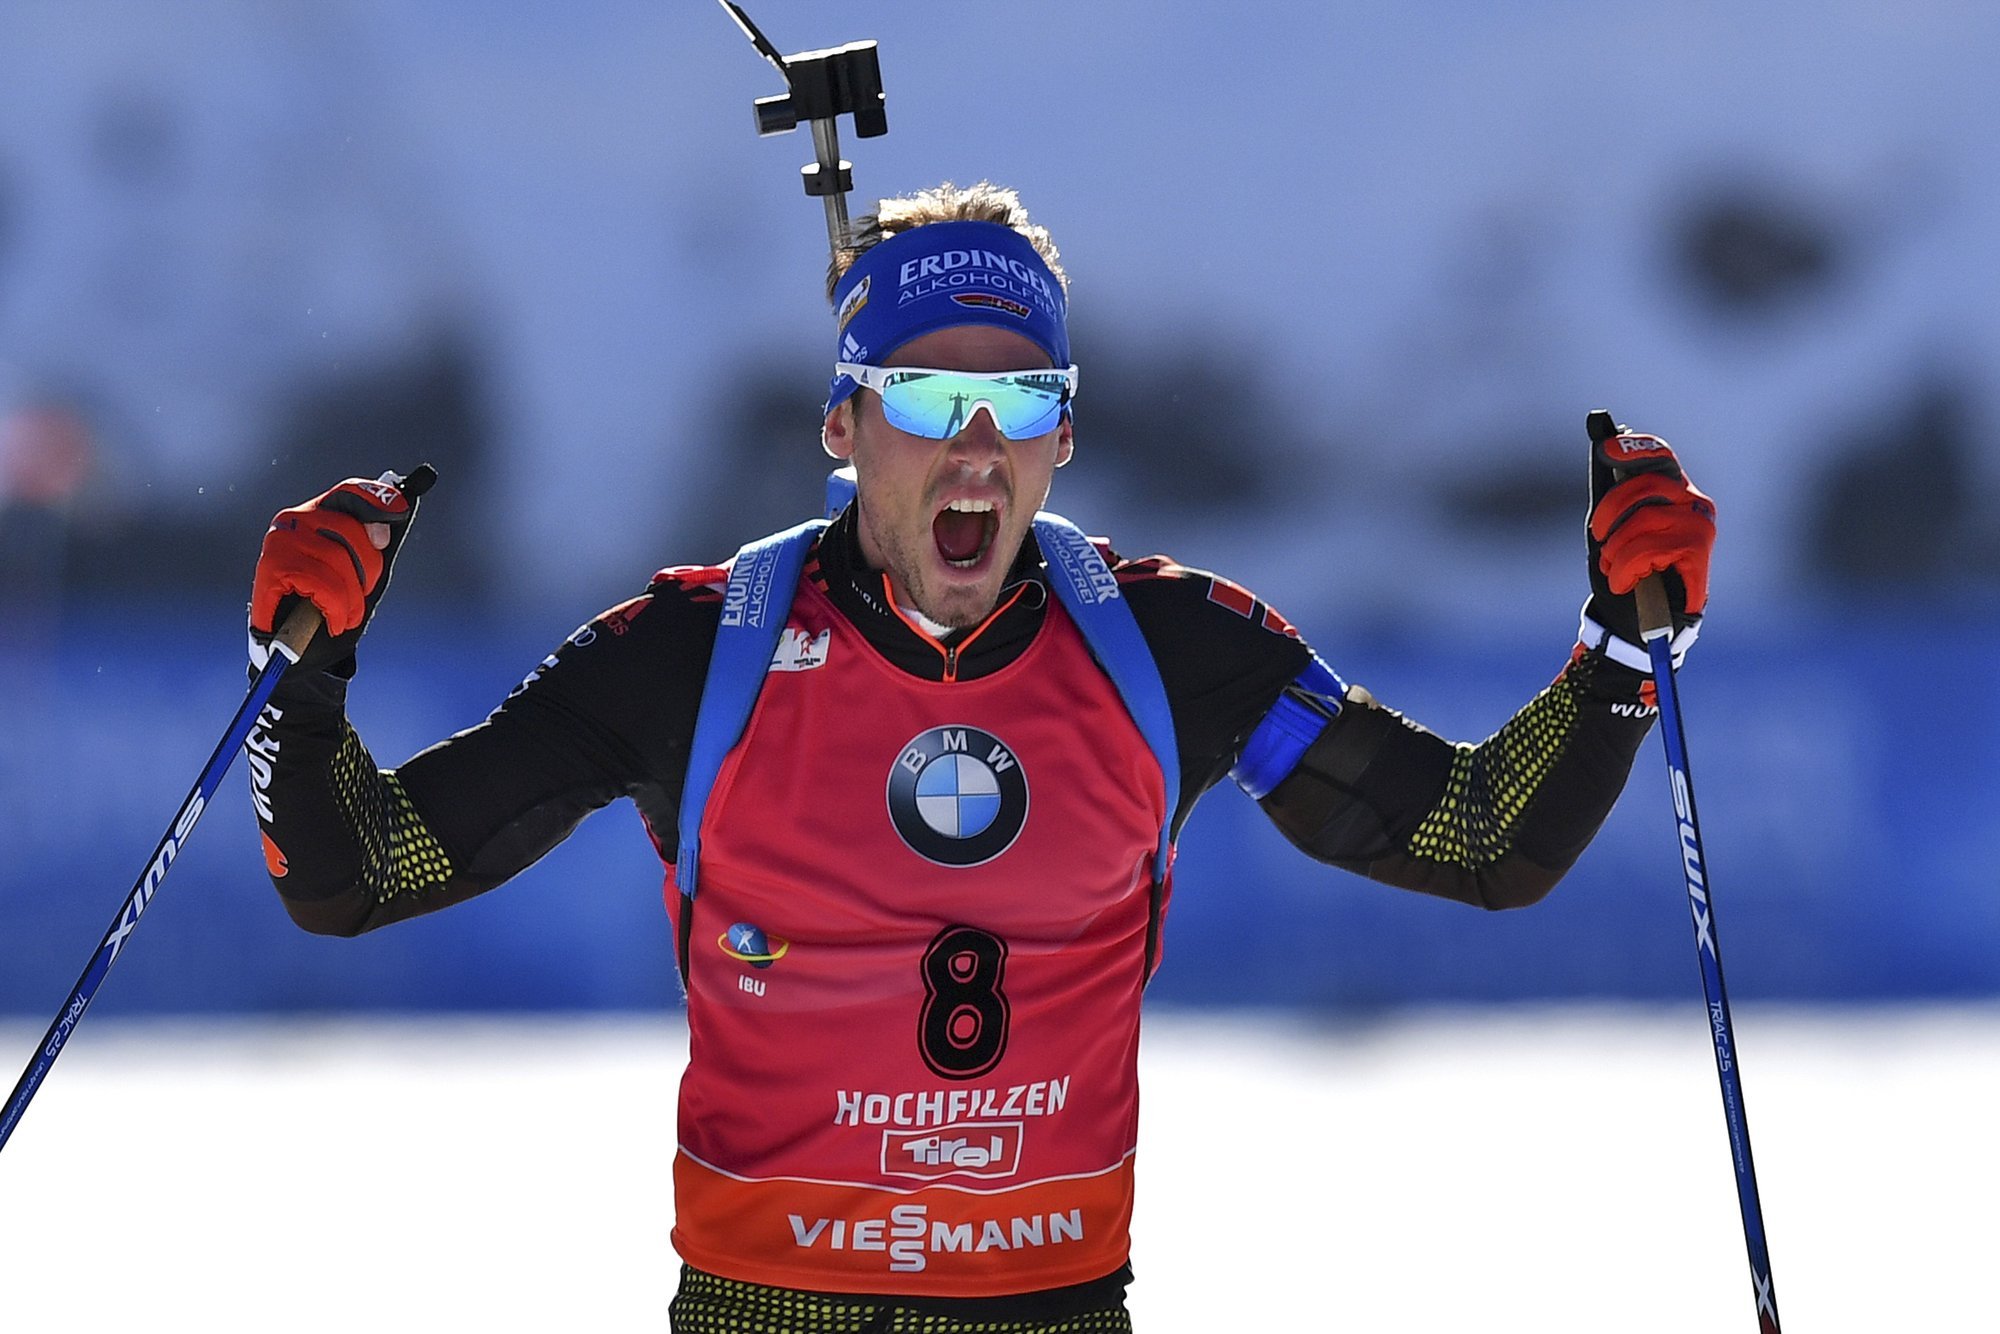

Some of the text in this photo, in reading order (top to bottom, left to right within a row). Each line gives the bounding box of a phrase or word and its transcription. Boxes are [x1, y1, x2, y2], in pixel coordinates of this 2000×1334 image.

[899, 249, 1057, 313] ERDINGER
[1061, 527, 1119, 604] DINGER
[900, 729, 1015, 775] BMW
[104, 786, 204, 967] SWIX
[1668, 765, 1716, 962] SWIX
[60, 992, 87, 1036] TRIAC
[738, 974, 766, 997] IBU
[918, 924, 1011, 1081] 8
[1710, 1000, 1728, 1044] TRIAC
[833, 1075, 1070, 1126] HOCHFILZEN
[902, 1135, 1004, 1168] Tirol
[787, 1204, 1084, 1272] VIESSMANN
